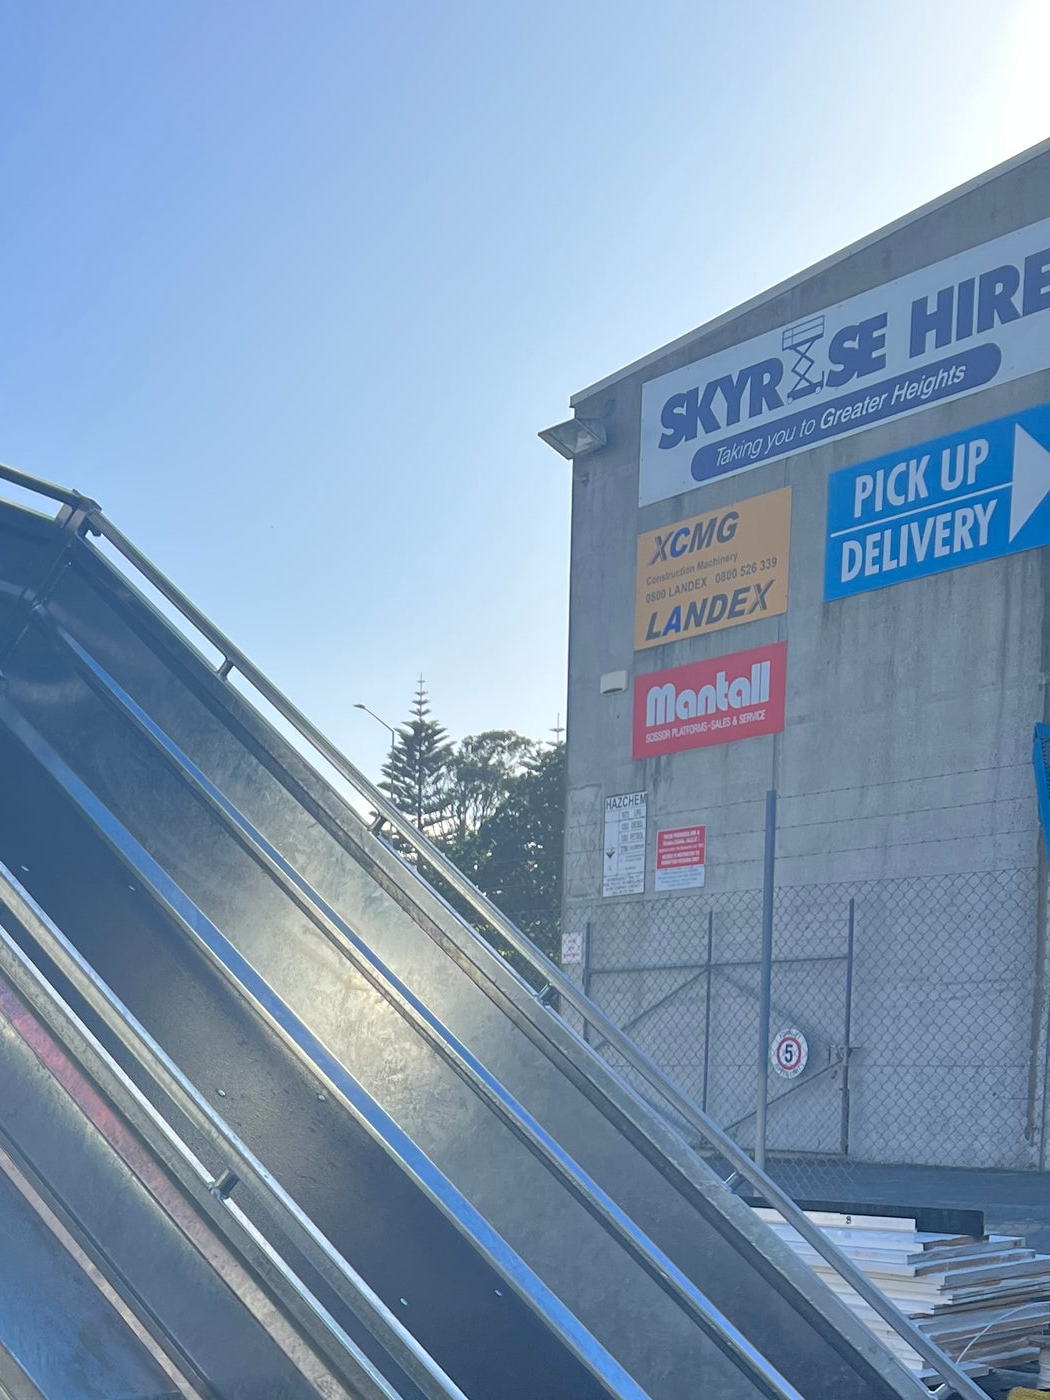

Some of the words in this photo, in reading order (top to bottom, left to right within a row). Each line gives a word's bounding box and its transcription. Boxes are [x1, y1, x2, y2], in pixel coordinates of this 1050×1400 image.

[909, 247, 1050, 359] HIRE
[716, 432, 764, 467] Taking
[765, 421, 798, 453] you
[800, 417, 817, 436] to
[820, 393, 888, 430] Greater
[891, 364, 967, 405] Heights
[853, 454, 932, 519] PICK
[940, 438, 990, 491] UP
[649, 511, 740, 566] XCMG
[840, 499, 999, 583] DELIVERY
[646, 566, 695, 586] Construction
[697, 552, 739, 571] Machinery
[646, 589, 667, 604] 0800
[668, 576, 708, 597] LANDEX
[715, 569, 738, 584] 0800
[740, 564, 757, 578] 526
[759, 556, 778, 571] 339
[645, 579, 776, 641] LANDEX
[646, 660, 771, 728] Mantall
[645, 729, 671, 744] SCISSOR
[732, 714, 738, 726] &
[739, 709, 767, 725] SERVICE
[606, 793, 647, 810] HAZCHEM
[784, 1043, 794, 1064] 5
